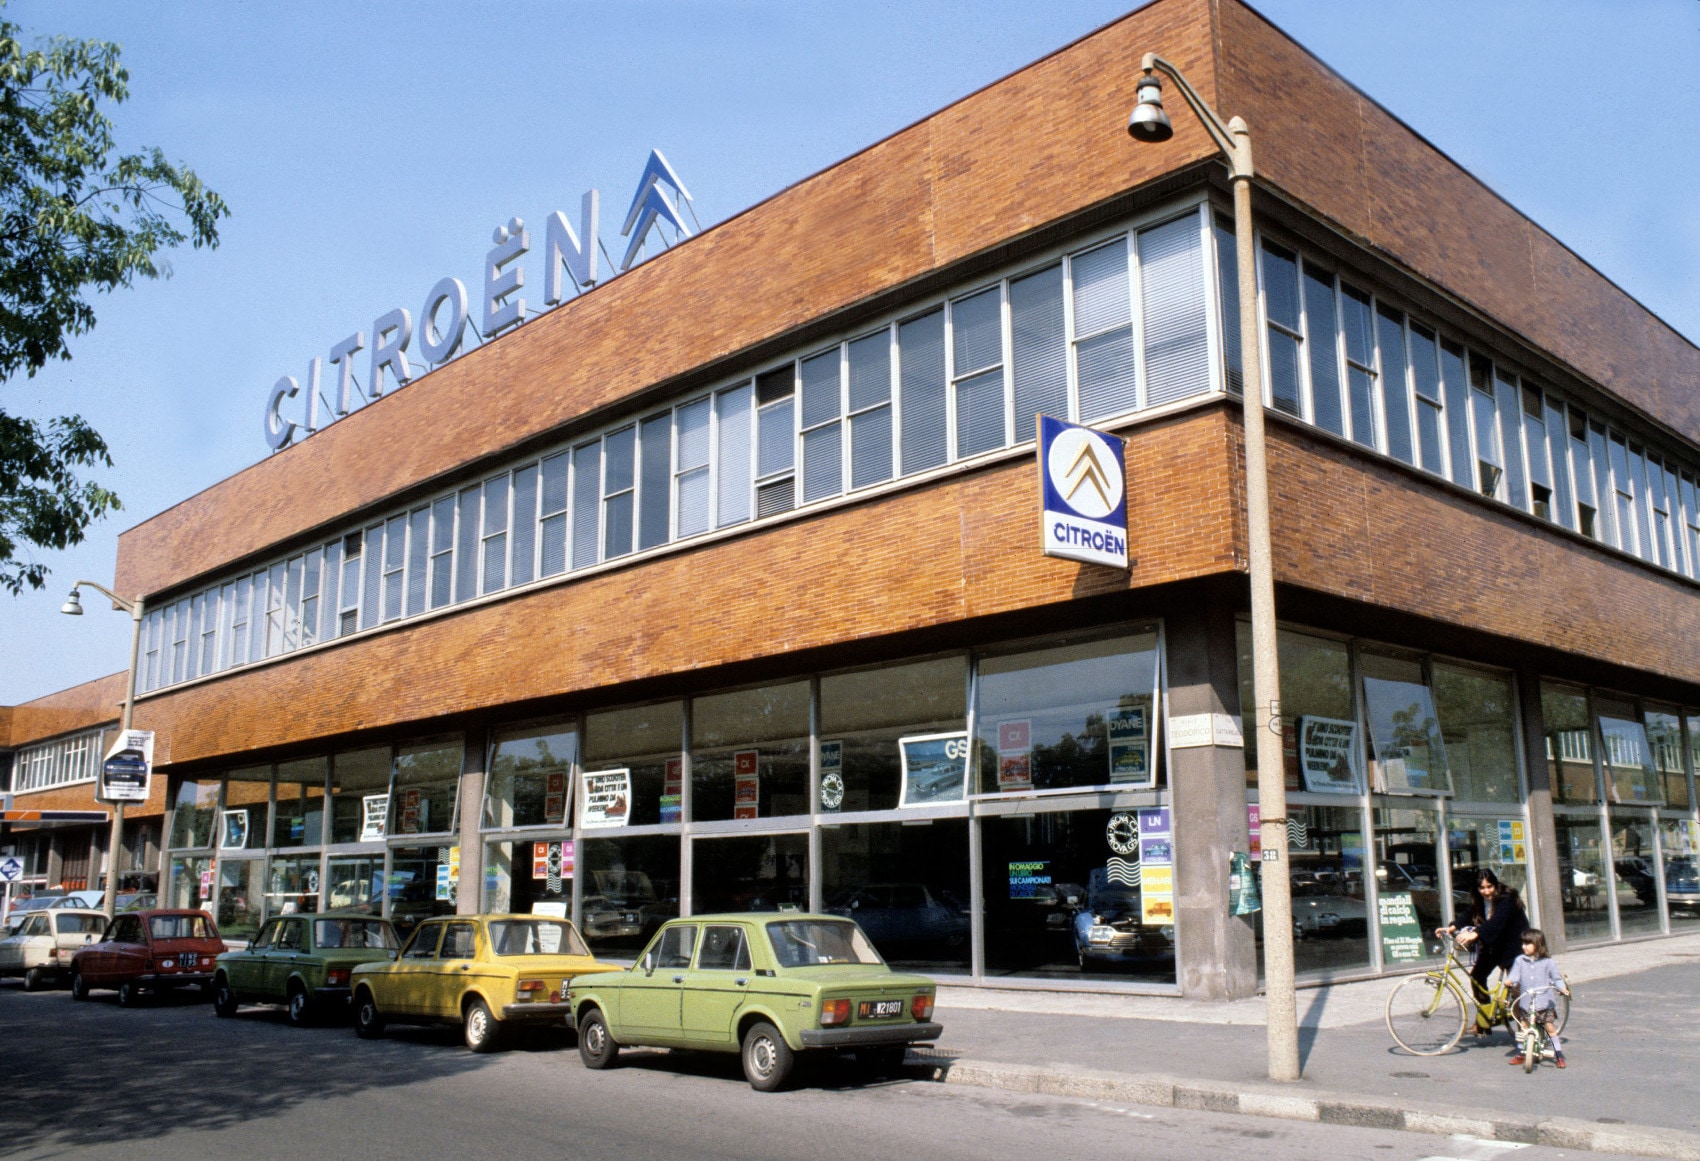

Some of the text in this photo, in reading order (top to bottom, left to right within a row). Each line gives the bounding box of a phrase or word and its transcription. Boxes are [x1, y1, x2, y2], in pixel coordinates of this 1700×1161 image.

[264, 188, 599, 450] CITROËN
[1054, 522, 1125, 556] CITROËN
[1110, 718, 1142, 731] DYANE
[1008, 731, 1021, 742] CX
[1171, 728, 1211, 739] TEODORICO
[945, 740, 968, 759] GS
[1148, 816, 1162, 827] LN
[1250, 813, 1259, 822] GS
[1263, 851, 1277, 861] 38
[1018, 876, 1051, 884] CAMPIONATI
[1379, 895, 1412, 906] mondiali
[1381, 904, 1411, 915] di calcio
[860, 1003, 871, 1015] MI
